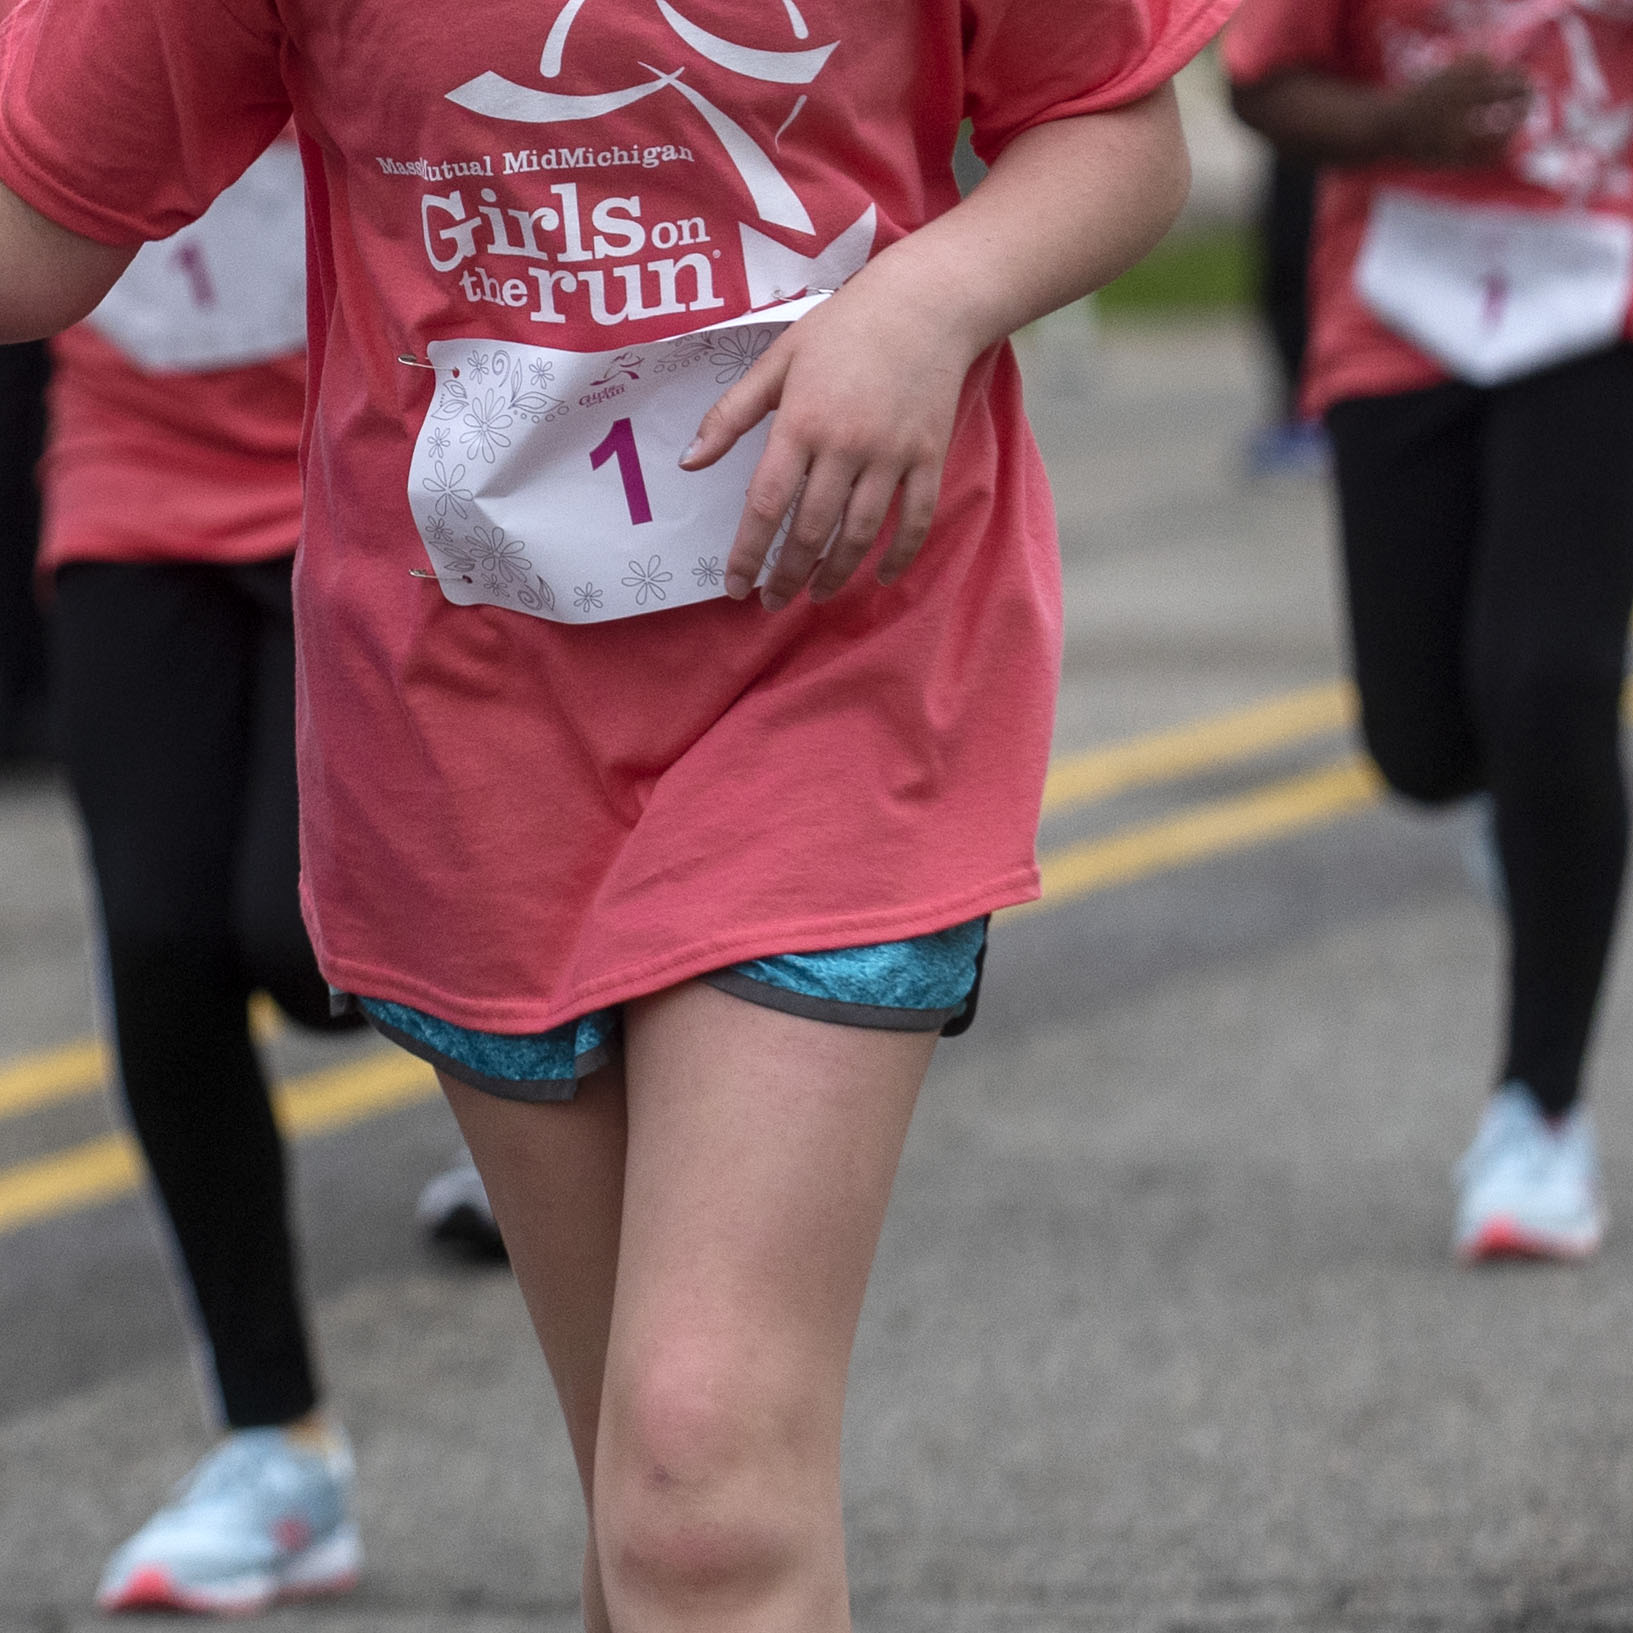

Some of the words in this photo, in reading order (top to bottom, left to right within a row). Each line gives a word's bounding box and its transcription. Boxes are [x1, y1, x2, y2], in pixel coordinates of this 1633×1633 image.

[502, 144, 695, 175] MidMichigan
[421, 182, 646, 272] Girls
[651, 216, 711, 249] on
[459, 267, 528, 307] the
[528, 251, 724, 325] run
[589, 417, 654, 526] 1
